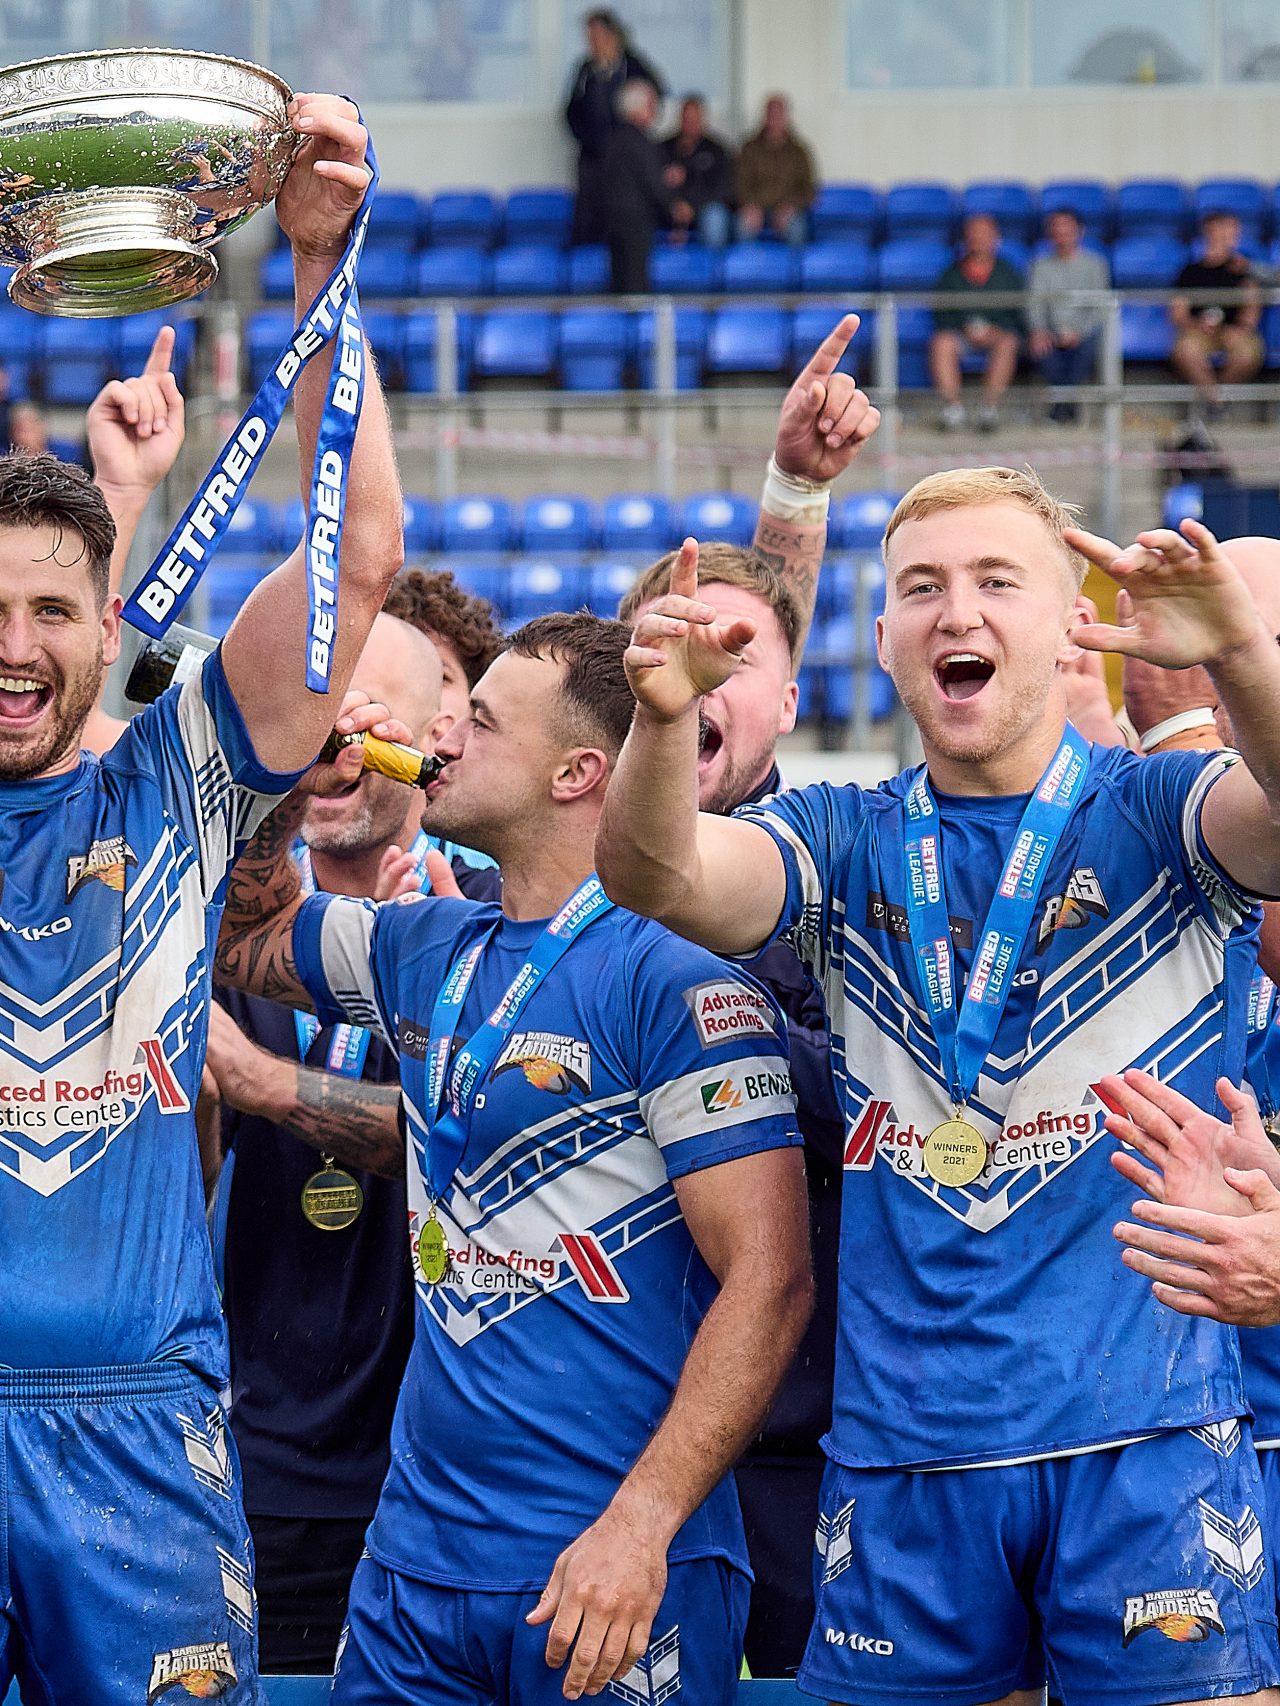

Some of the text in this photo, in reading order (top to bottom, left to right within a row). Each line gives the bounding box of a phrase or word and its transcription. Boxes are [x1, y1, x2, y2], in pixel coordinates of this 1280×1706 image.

[276, 207, 371, 390] BETFR
[137, 416, 267, 624] BETFRED
[310, 450, 344, 678] BETFRED
[1038, 744, 1074, 802] BETFRED
[1059, 763, 1079, 798] LEAGUE
[67, 843, 138, 895] RAIDE
[908, 853, 925, 899] LEAGUE
[921, 837, 941, 904] BETFRED
[1000, 830, 1035, 897] BETFRED
[1022, 842, 1046, 887] LEAGUE
[549, 879, 602, 934] BETFRED
[568, 894, 605, 929] LEAGUE
[924, 957, 939, 1006] LEAGUE
[933, 938, 952, 1009] BETFRED
[969, 931, 1001, 1001] BETFRED
[987, 944, 1012, 993] LEAGUE
[489, 963, 533, 1026] BETFRED
[506, 974, 536, 1018] LEAGUE
[702, 992, 768, 1015] Advance
[527, 1031, 574, 1045] BARROW
[704, 1010, 764, 1035] Roofing
[496, 1033, 591, 1089] RAIDERS
[745, 1073, 795, 1100] BEND
[897, 1140, 1066, 1171] & Centre
[933, 1142, 978, 1155] WINNERS
[943, 1155, 966, 1166] 2021
[1124, 1589, 1224, 1637] RAIDERS
[1145, 1588, 1197, 1601] BARROW
[149, 1642, 238, 1693] RAIDERS
[170, 1642, 216, 1657] BARROW
